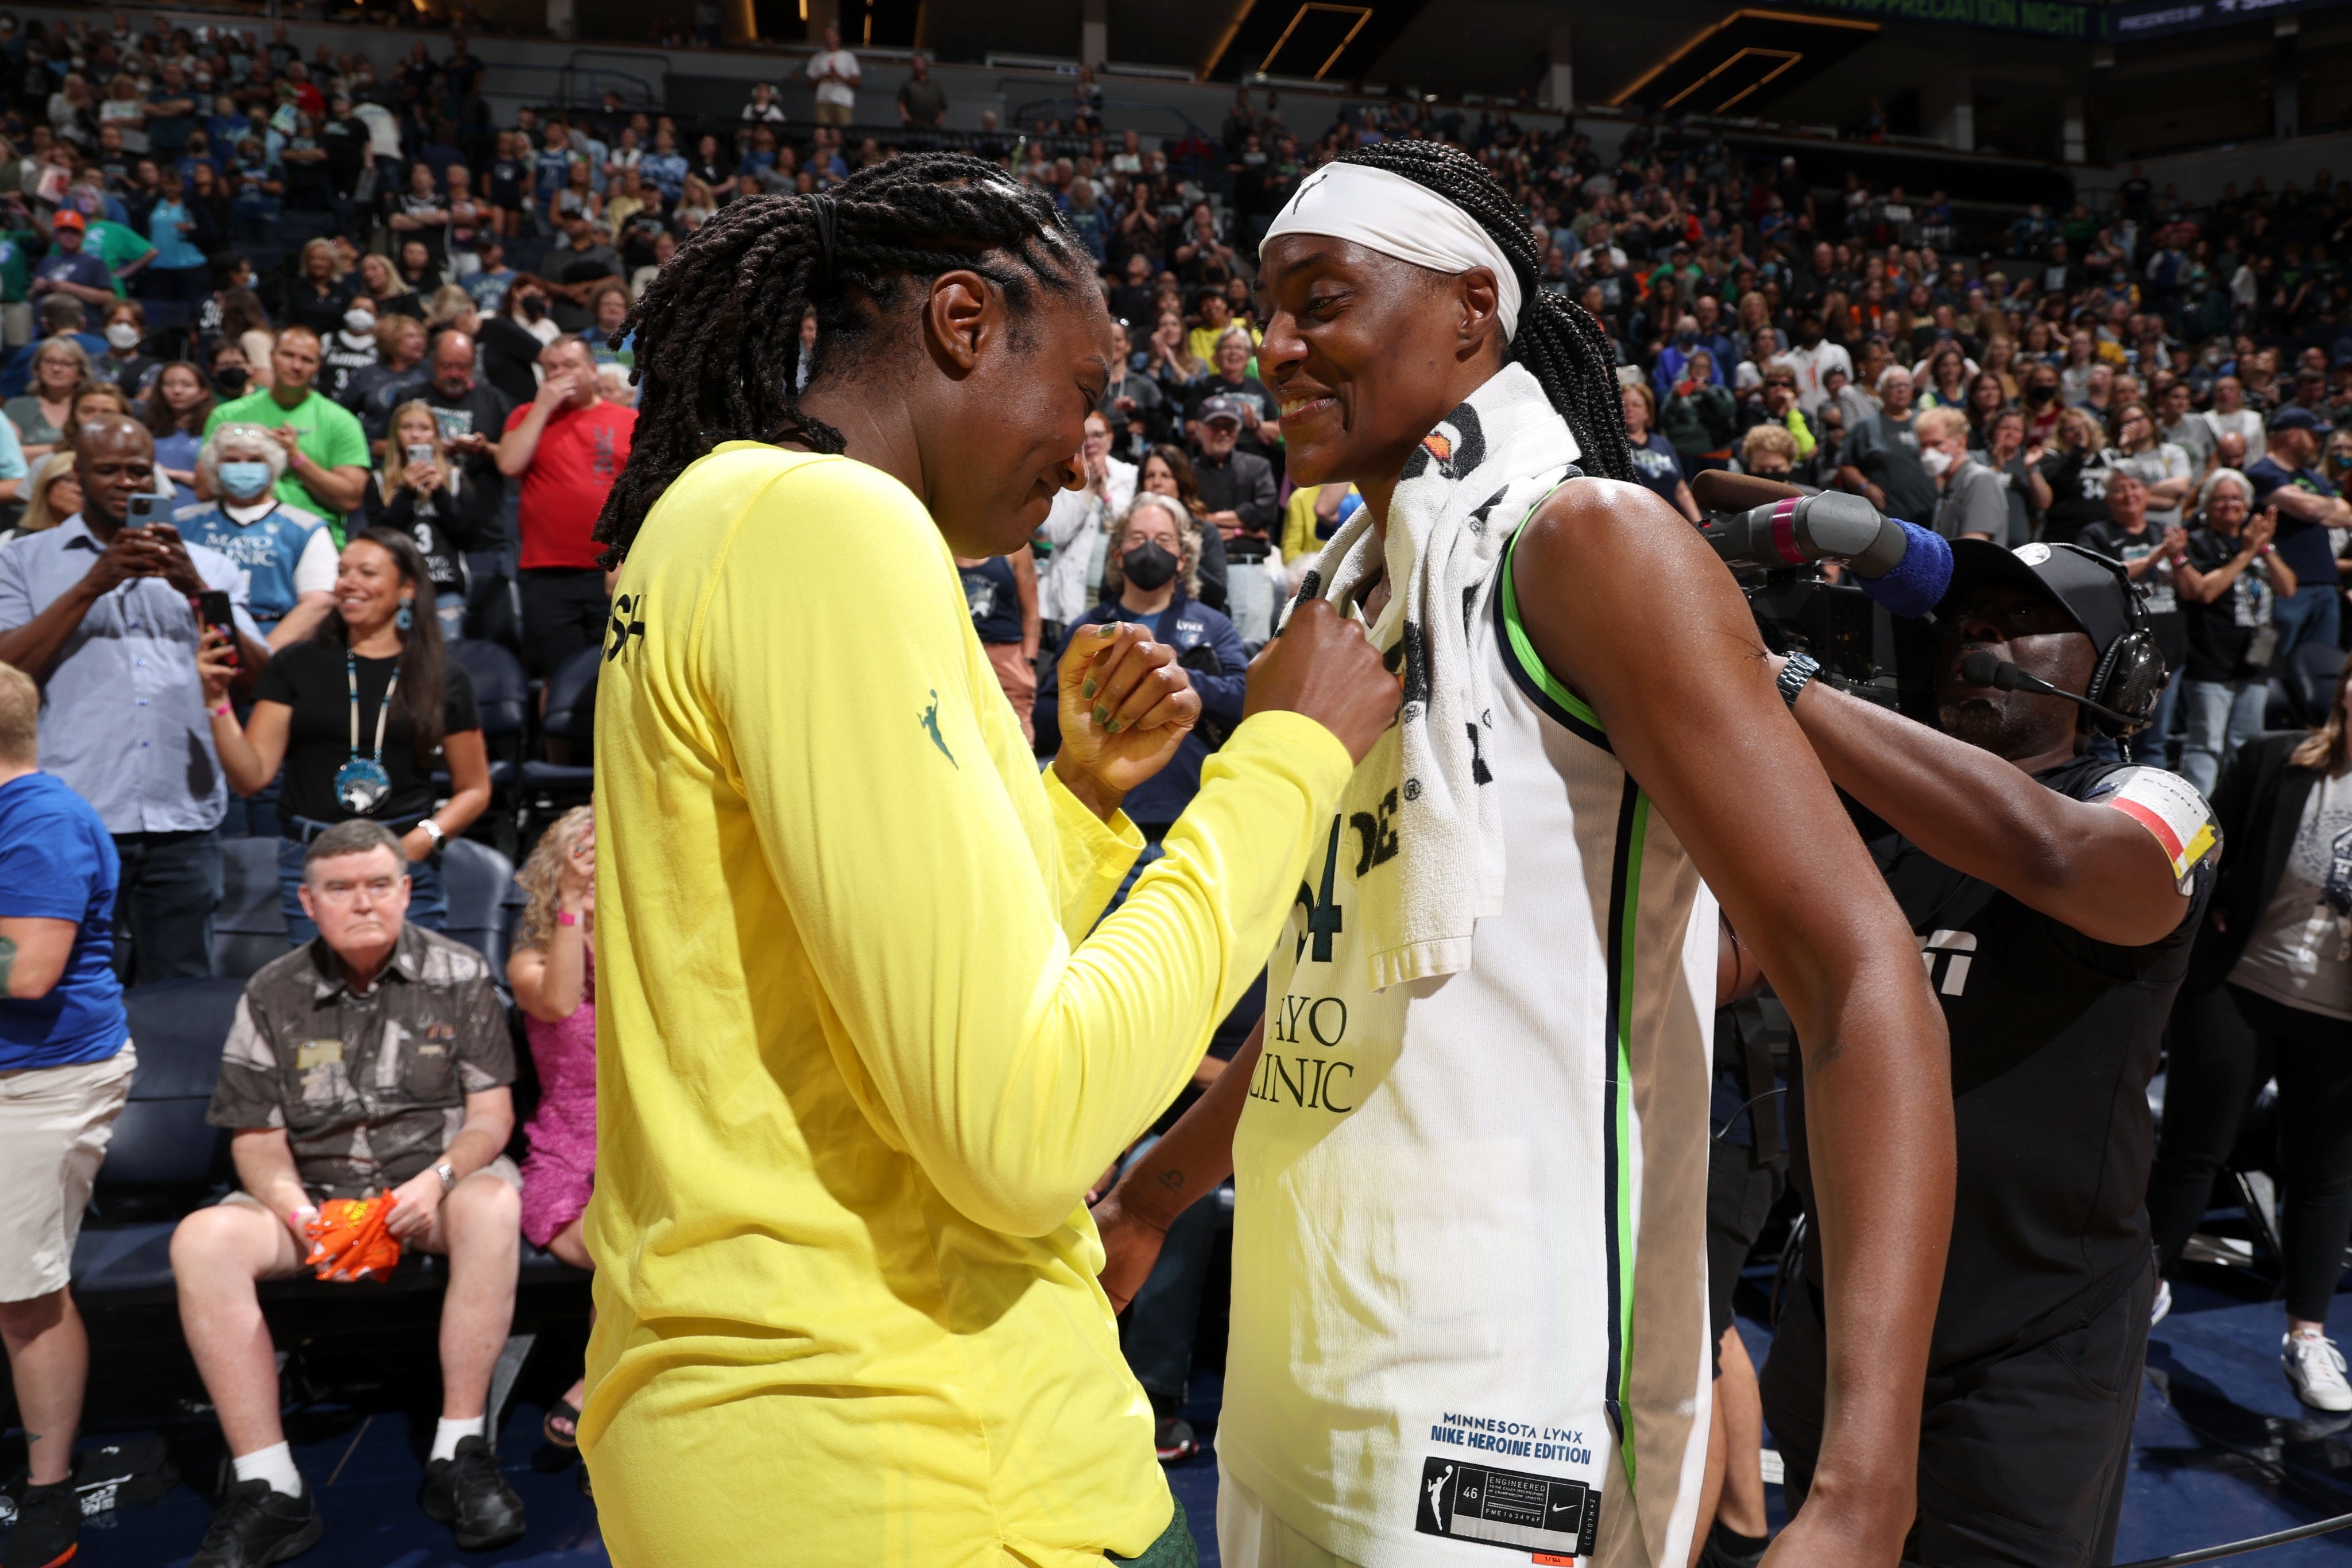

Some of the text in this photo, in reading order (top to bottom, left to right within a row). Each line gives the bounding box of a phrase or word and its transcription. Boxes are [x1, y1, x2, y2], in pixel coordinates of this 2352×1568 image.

[2021, 2, 2088, 33] NIGHT
[206, 532, 273, 549] MAYO
[1176, 619, 1204, 633] LYNX
[2143, 777, 2201, 816] EVENT
[1444, 1412, 1583, 1444] MINNESOTA LYNX
[1431, 1426, 1591, 1465] NIKE HEROINE EDITION
[1463, 1486, 1478, 1499] 46
[1490, 1477, 1545, 1492] ENGINEERED
[1585, 1511, 1594, 1546] LENGTH
